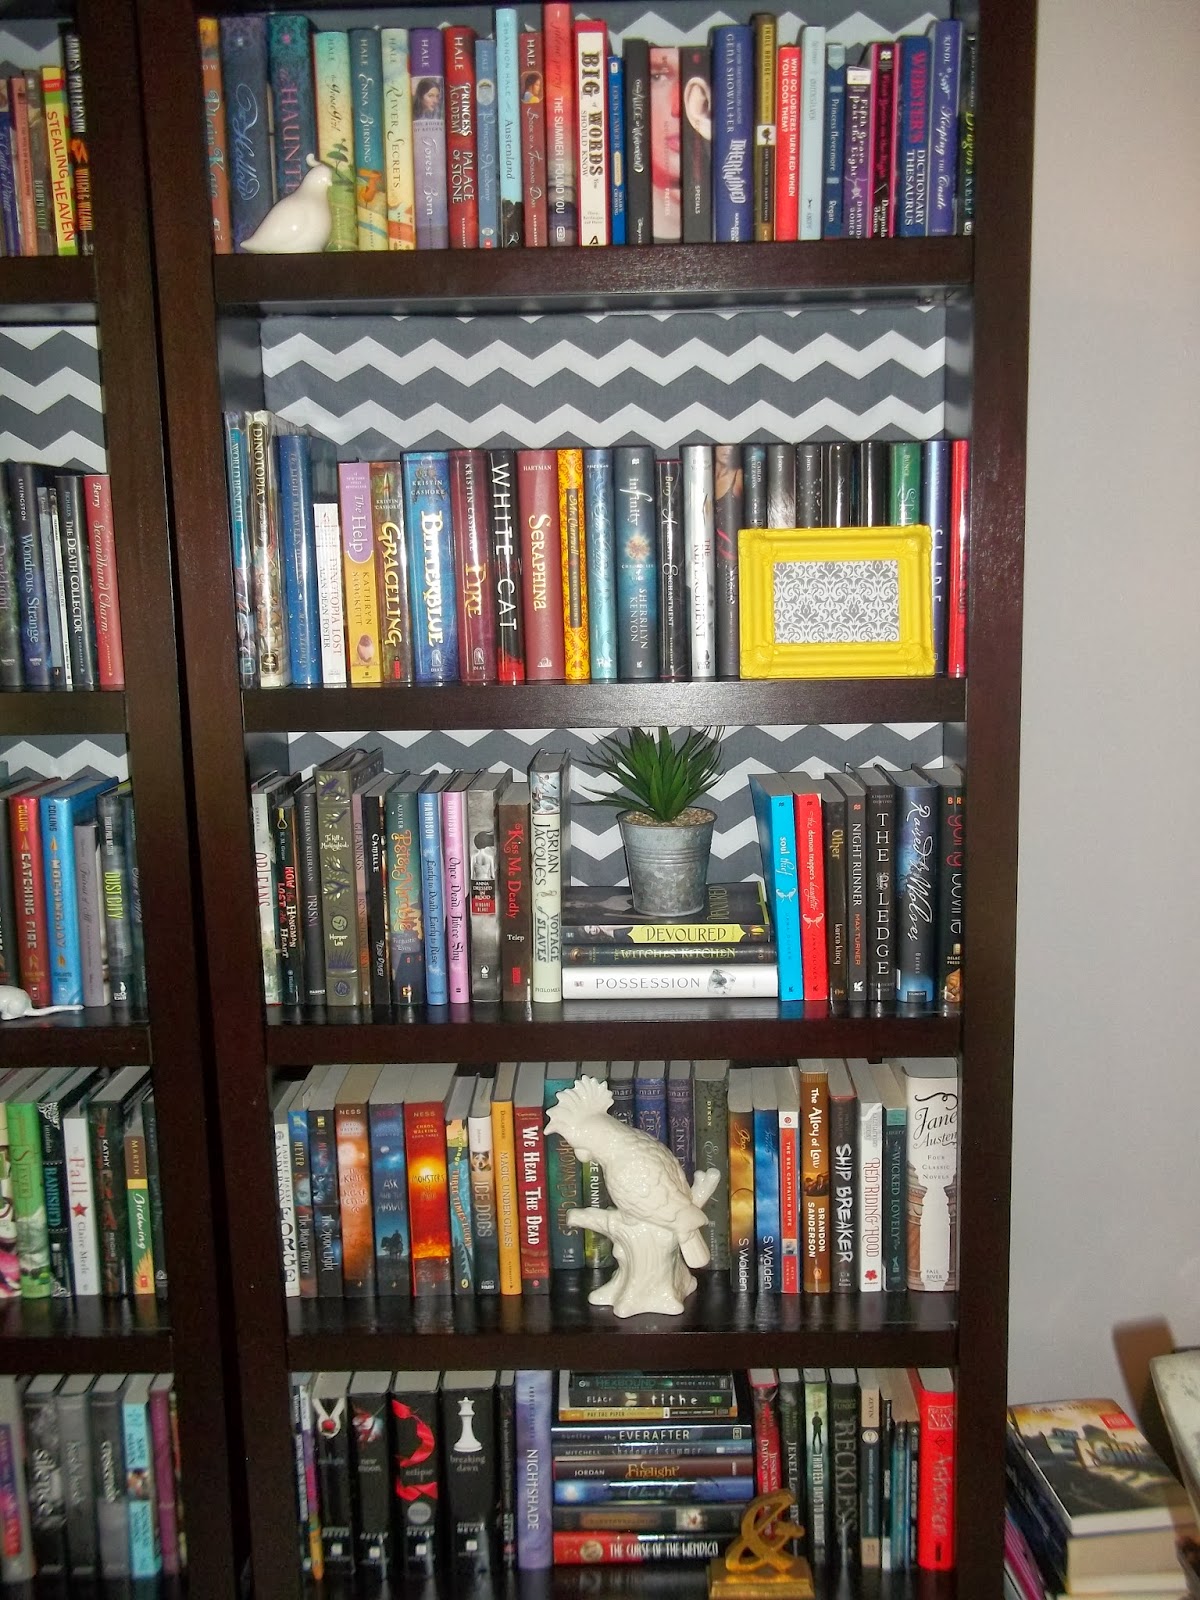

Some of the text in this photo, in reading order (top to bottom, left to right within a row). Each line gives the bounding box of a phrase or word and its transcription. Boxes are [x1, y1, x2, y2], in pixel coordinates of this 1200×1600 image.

[360, 39, 368, 66] HALE
[421, 39, 429, 67] HALE
[454, 37, 463, 71] HALE
[527, 39, 535, 67] HALE
[581, 51, 600, 97] BIG
[554, 97, 564, 113] THE
[790, 79, 797, 92] DO
[910, 50, 926, 144] WEBSTER'S
[450, 85, 462, 134] ACADEMY
[460, 83, 472, 137] PRINCESS
[789, 95, 797, 131] LOBSTERS
[935, 106, 952, 155] Keeping
[386, 86, 404, 188] RIVER SECRETS
[422, 138, 437, 176] Forest
[504, 119, 515, 180] Austenland
[554, 116, 564, 155] SUMMER
[589, 111, 603, 176] WORDS
[830, 99, 841, 171] Princess Nevermore
[47, 111, 74, 242] STEALING HEAVEN
[452, 164, 462, 203] STONE
[462, 151, 474, 200] PALACE
[555, 163, 564, 194] FOUND
[581, 150, 589, 177] KNOW
[722, 139, 747, 204] INTERTWINED
[423, 185, 438, 215] Born
[555, 197, 564, 213] YOU
[905, 149, 915, 226] THESAURUS
[916, 149, 926, 225] DICTIONARY
[937, 175, 950, 210] Castle
[827, 200, 836, 222] Regan
[253, 428, 266, 497] DINOTOPIA
[776, 455, 784, 472] Jones
[805, 455, 813, 472] Jones
[18, 478, 27, 521] LIVINGSTON
[91, 483, 101, 508] Berry
[354, 494, 364, 513] The
[465, 463, 475, 552] KRISTIN CASHORE
[620, 478, 653, 526] infinity
[664, 475, 674, 497] Berry
[351, 515, 367, 553] Help
[491, 462, 517, 631] WHITE CAT
[66, 520, 83, 634] THE DEATH COLLECTOR
[92, 520, 111, 633] Secondhand Charm
[378, 521, 402, 646] GRACELING
[421, 511, 444, 647] BITTERBLUE
[528, 514, 552, 612] SERAPHINA
[22, 533, 39, 643] Wondrous Strange
[329, 558, 341, 657] DINOTOPIA LOST
[352, 571, 362, 626] STOCKETT
[362, 571, 372, 626] KATHRYN
[463, 563, 486, 619] FIRE
[629, 596, 638, 643] KENYON
[638, 588, 648, 649] SHERRILYN
[18, 805, 28, 832] COLLINS
[48, 805, 57, 832] COLLINS
[424, 802, 434, 839] HARRISON
[354, 822, 363, 871] GLEANINGS
[371, 833, 381, 872] CAMILLE
[532, 817, 550, 886] JACQUES
[546, 829, 560, 874] BRIAN
[776, 836, 794, 877] soul thief
[830, 829, 843, 860] Other
[852, 823, 862, 906] NIGHT RUNNER
[284, 866, 295, 888] HOW
[504, 823, 524, 919] Kiss Me Deadly
[21, 853, 36, 949] CATCHING FIRE
[104, 871, 123, 919] DUST CITY
[277, 882, 286, 907] LOST
[306, 895, 318, 927] PRISM
[286, 905, 297, 948] HANGMAN
[507, 934, 525, 942] Telep
[537, 918, 547, 962] SLAVES
[550, 913, 559, 962] VOYAGE
[646, 927, 726, 942] DEVOURED
[596, 977, 700, 989] POSSESSION
[809, 1088, 822, 1168] The Alloy of Law
[102, 1139, 110, 1167] KATHY
[131, 1140, 141, 1175] MARTIN
[835, 1143, 853, 1182] SHIP
[863, 1157, 880, 1183] RED
[69, 1156, 88, 1196] Fall
[522, 1125, 543, 1245] WE HEAR THE DEAD
[891, 1151, 900, 1239] WICKED LOVELY
[134, 1193, 146, 1249] Birdwing
[474, 1181, 492, 1237] ICE DOGS
[500, 1151, 513, 1248] MAGIC UNDER GLASS
[863, 1185, 880, 1225] RIDING
[808, 1202, 816, 1258] SANDERSON
[818, 1207, 826, 1252] BRANDON
[835, 1186, 854, 1263] BREAKER
[862, 1226, 880, 1258] HOOD
[738, 1238, 749, 1291] S Walden
[763, 1246, 774, 1289] Walden
[651, 1394, 698, 1405] tithe
[619, 1430, 690, 1440] EVERAFTER
[526, 1449, 539, 1530] NIGHTSHADE
